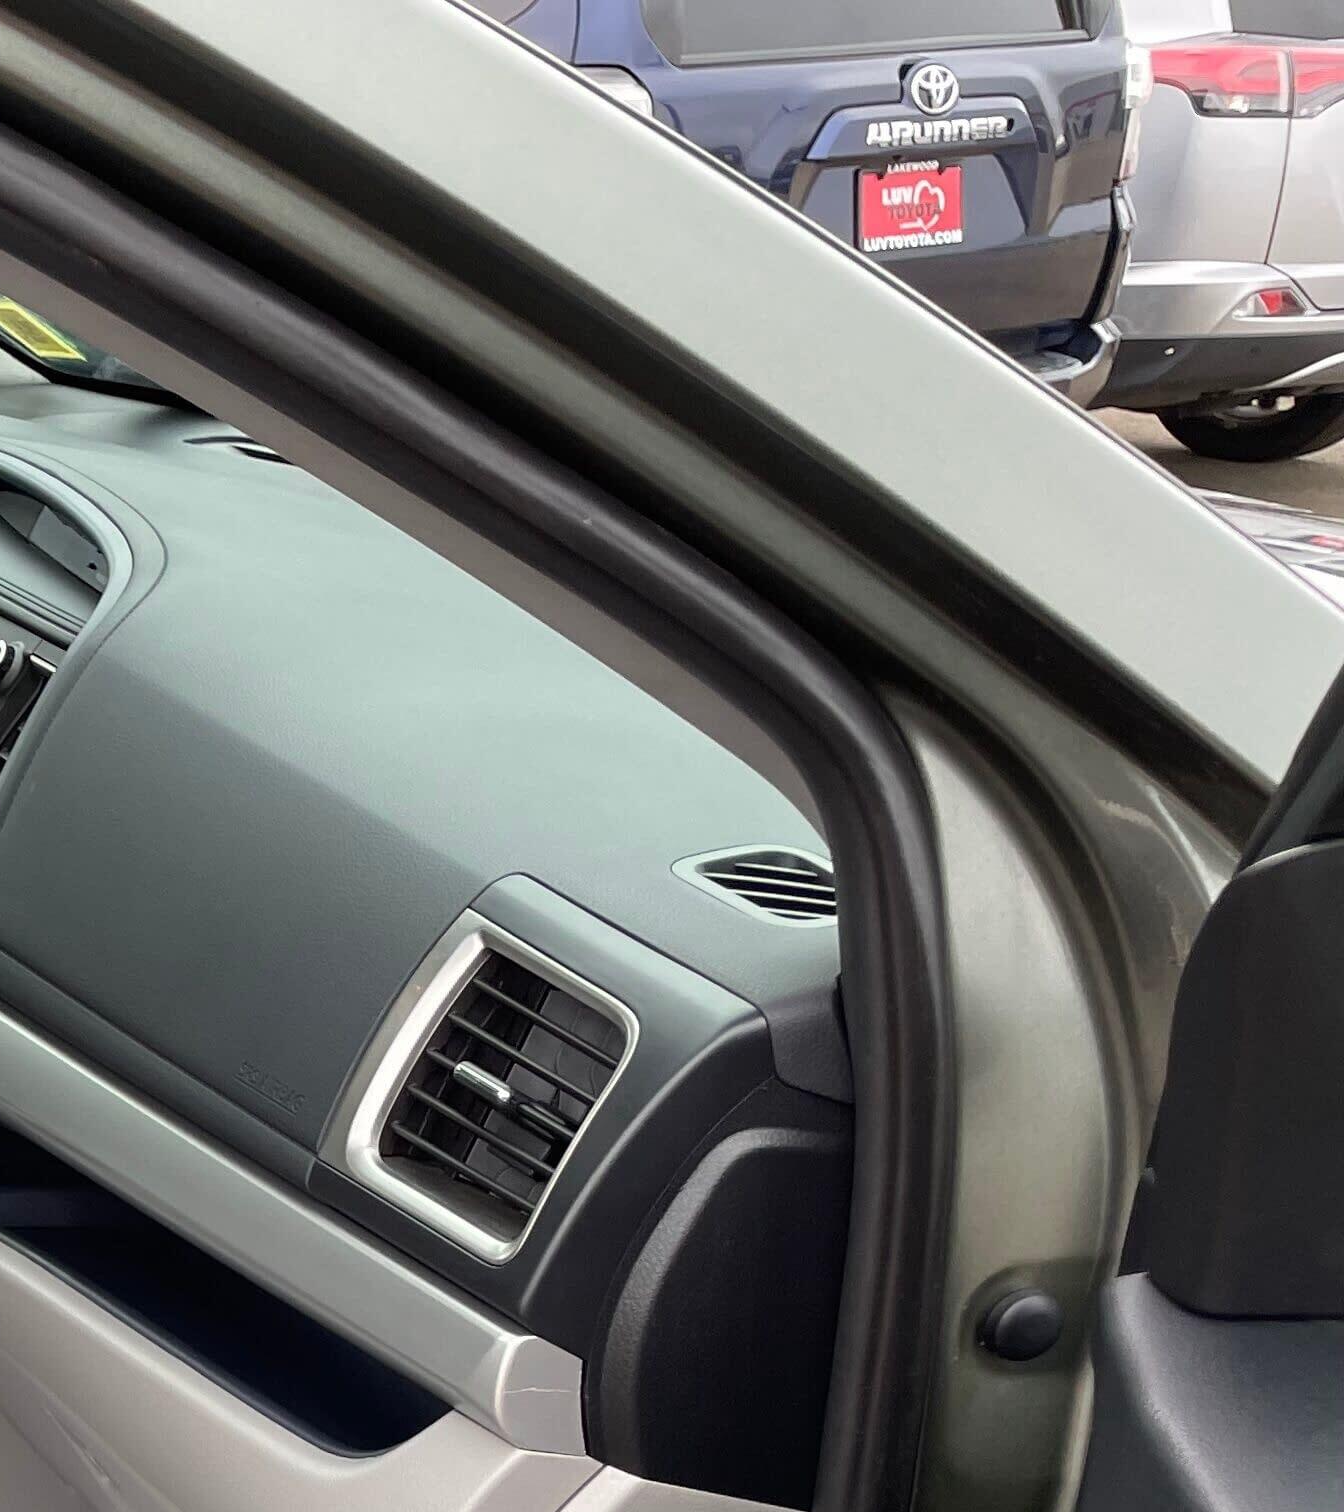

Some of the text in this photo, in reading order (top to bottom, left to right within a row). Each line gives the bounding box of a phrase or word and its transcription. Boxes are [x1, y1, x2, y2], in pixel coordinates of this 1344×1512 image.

[887, 160, 939, 173] LAKEWOOD
[882, 186, 912, 205] LUV
[889, 203, 943, 218] TOYOTA
[864, 229, 962, 252] LUVTOYOTA.COM
